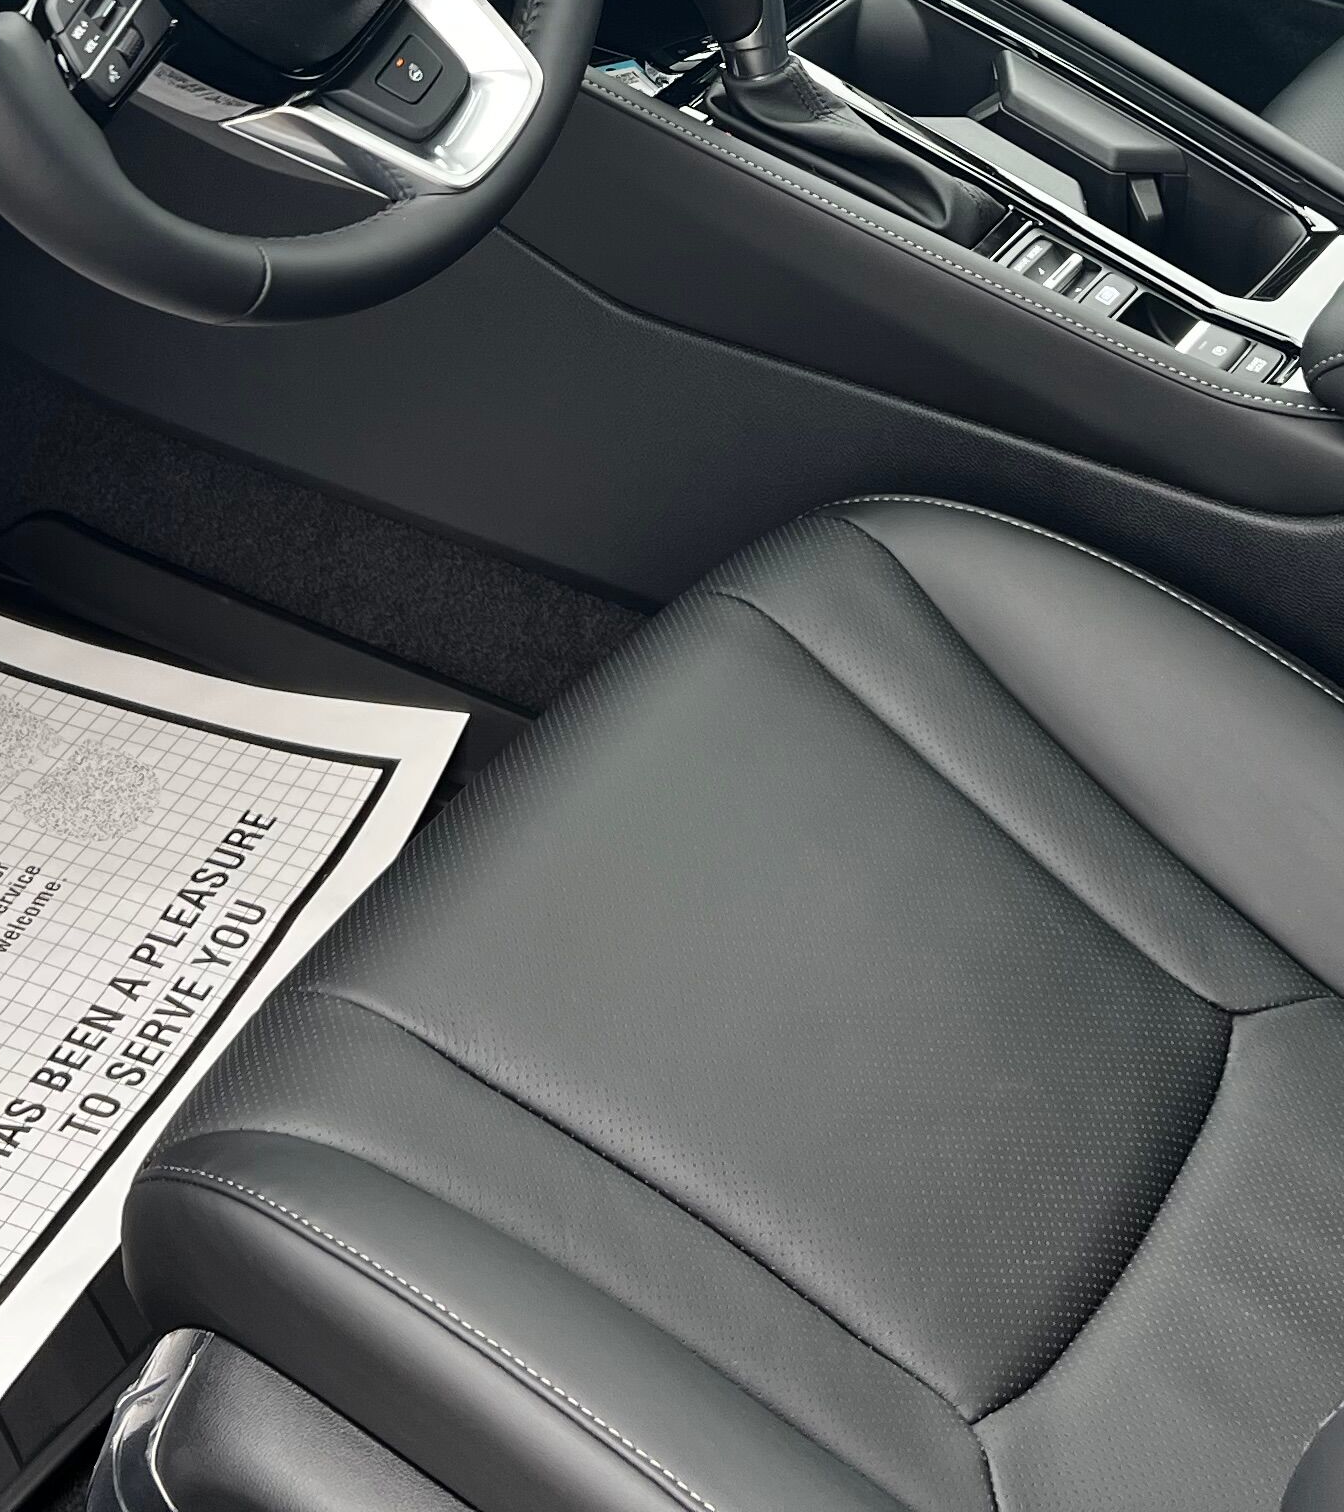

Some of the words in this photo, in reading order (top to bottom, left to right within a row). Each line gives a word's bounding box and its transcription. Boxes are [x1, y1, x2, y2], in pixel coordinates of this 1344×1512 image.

[29, 1003, 125, 1092] BEEN
[108, 974, 151, 1001] A
[130, 808, 278, 969] PLEASURE
[58, 1093, 122, 1136] TO
[106, 976, 214, 1088] SERVE
[192, 899, 267, 967] YOU
